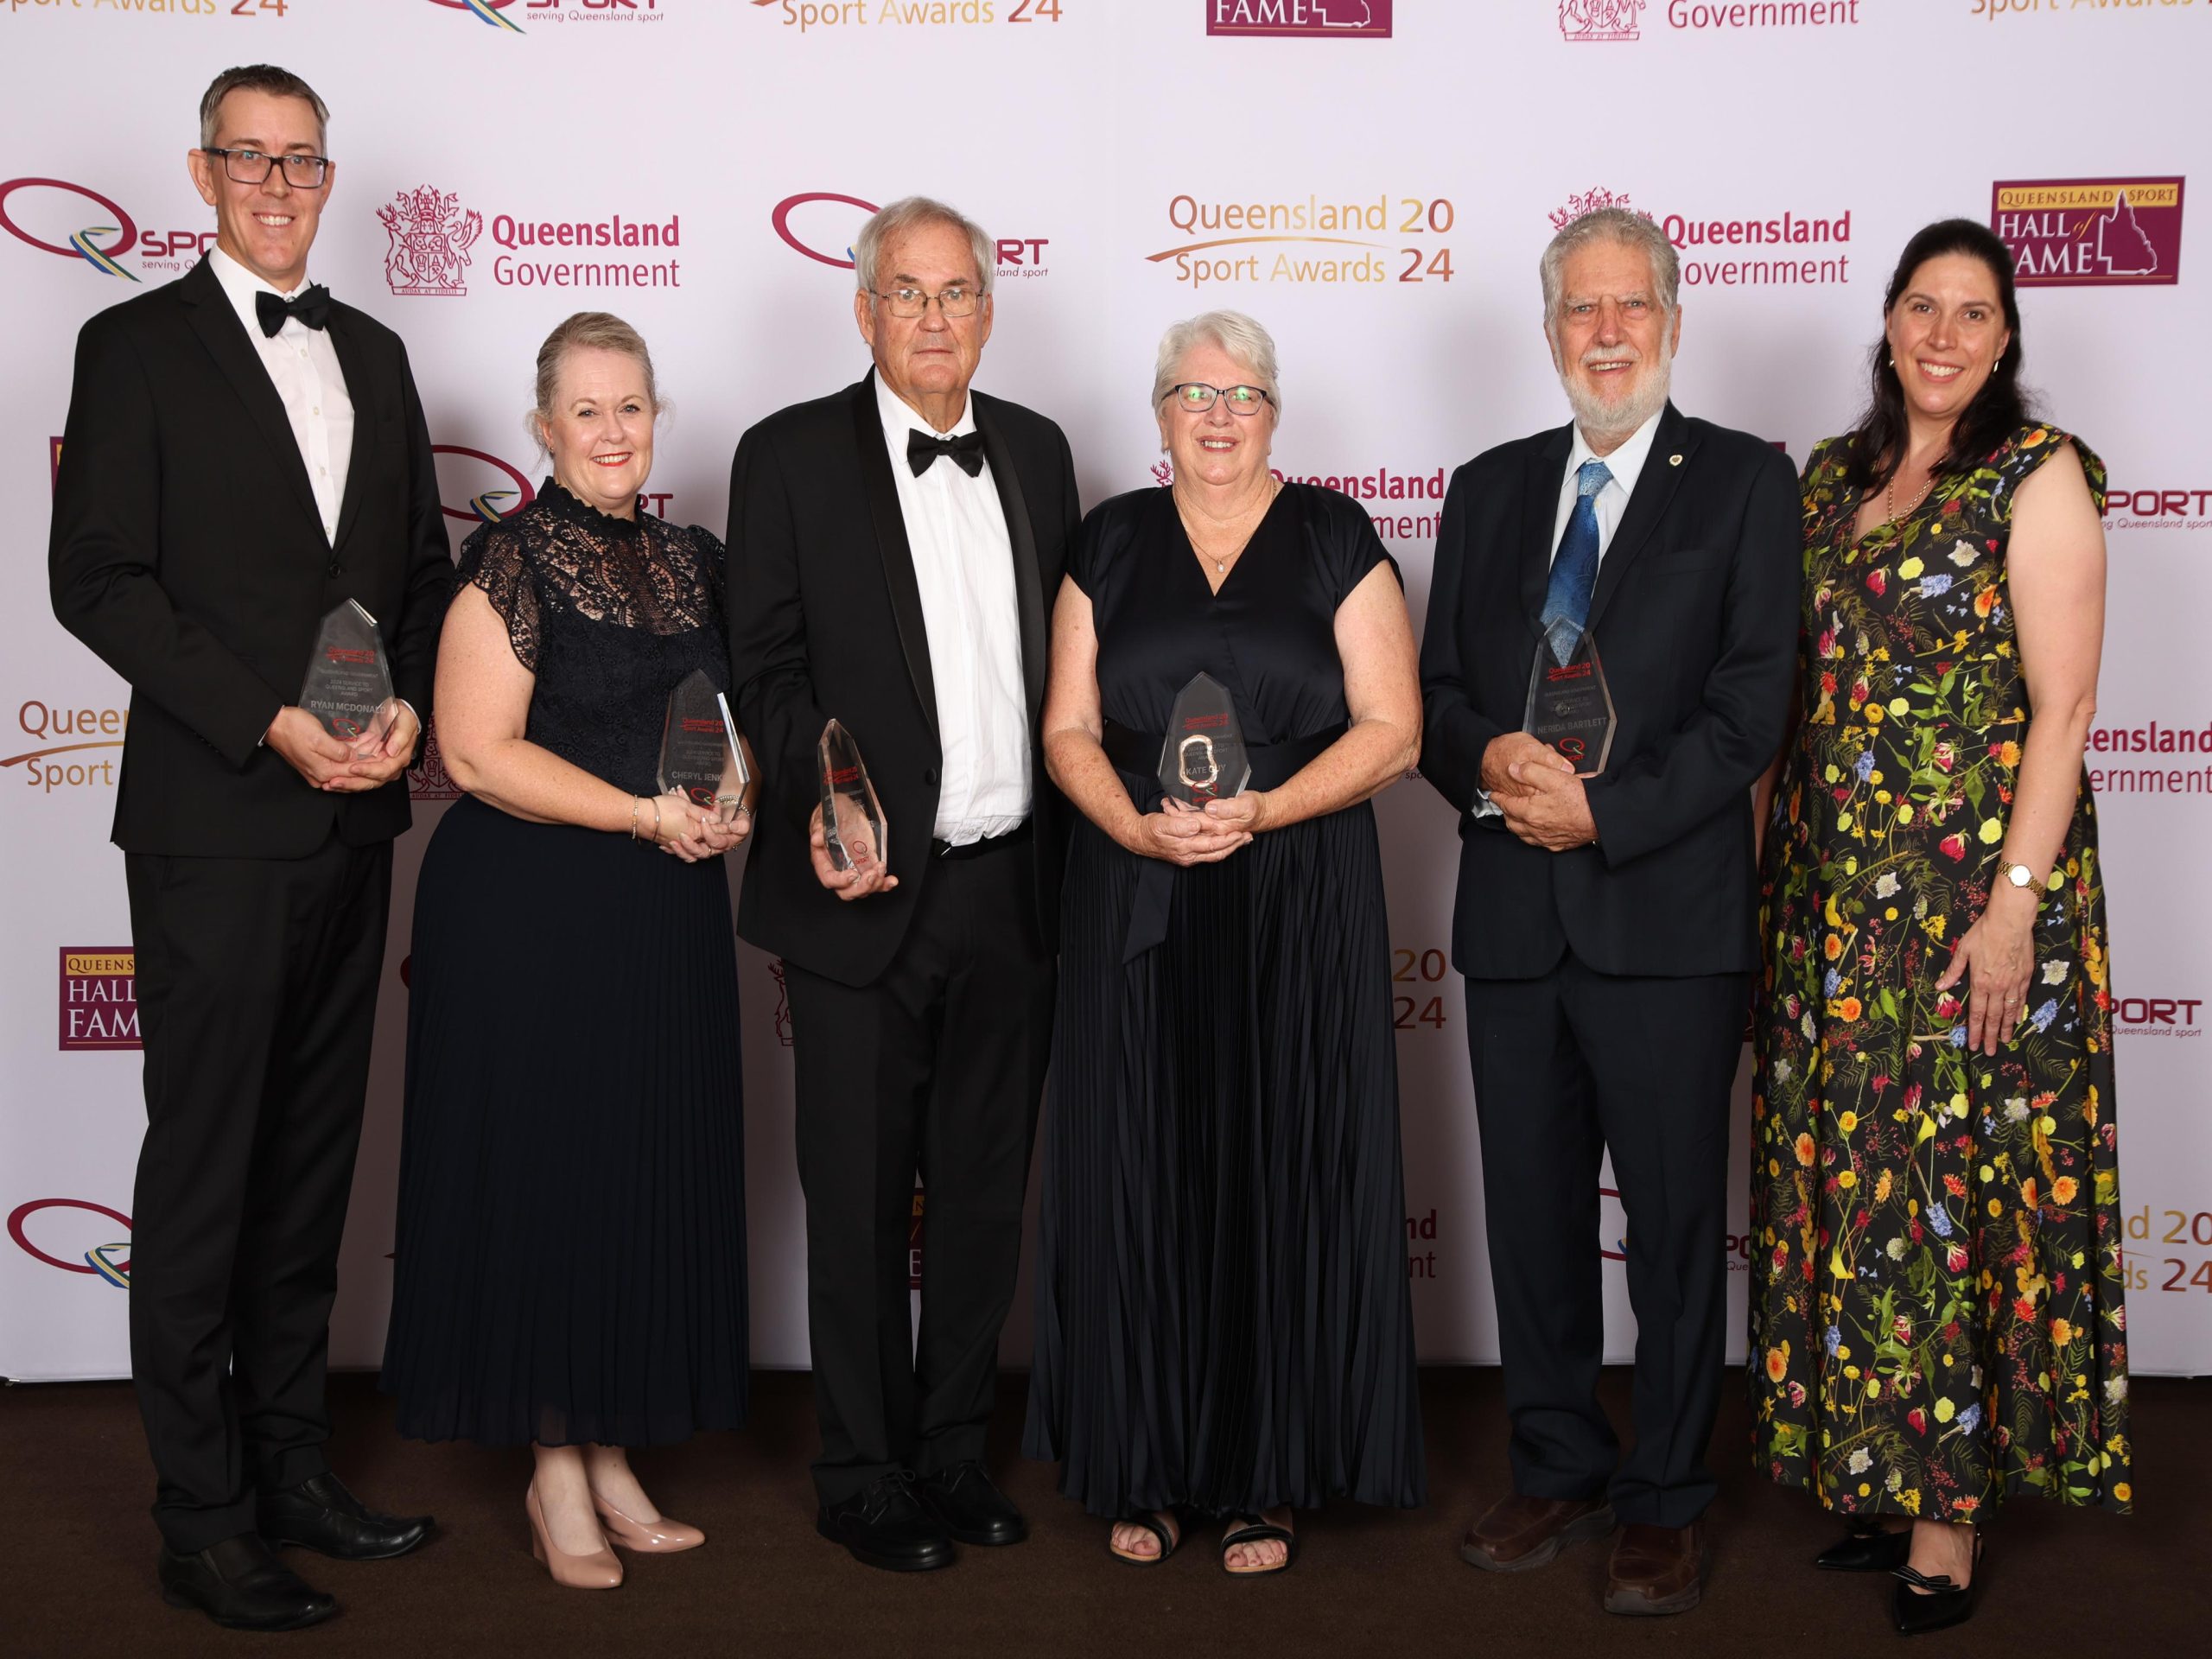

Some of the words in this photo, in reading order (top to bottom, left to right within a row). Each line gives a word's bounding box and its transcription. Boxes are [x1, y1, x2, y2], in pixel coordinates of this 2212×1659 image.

[526, 11, 564, 22] serving
[569, 10, 633, 22] Queensland
[638, 12, 664, 22] sport
[783, 0, 867, 33] Sport
[878, 0, 995, 25] Awards
[1007, 0, 1063, 22] 24
[1216, 0, 1307, 24] FAME
[1669, 0, 1859, 28] Government
[2000, 189, 2114, 207] QUEENSLAND
[2128, 188, 2177, 202] SPORT
[1169, 194, 1387, 235] Queensland
[1399, 199, 1454, 233] 20
[1999, 213, 2072, 238] HALL
[2073, 210, 2099, 243] of
[492, 214, 680, 250] Queensland
[1662, 210, 1851, 250] Queensland
[142, 259, 180, 271] serving
[493, 256, 680, 287] Government
[1175, 252, 1259, 289] Sport
[1269, 252, 1386, 283] Awards
[1398, 248, 1455, 283] 24
[1677, 255, 1850, 285] overnment
[2005, 242, 2094, 275] AME
[1022, 268, 1048, 279] sport
[2102, 491, 2212, 516] PORT
[2118, 518, 2183, 529] Queensland
[310, 700, 334, 710] RYAN
[335, 702, 386, 714] MCDONALD
[1537, 723, 1567, 735] NERIDA
[1567, 717, 1607, 730] BARTLETT
[2084, 721, 2212, 753] ensland
[27, 758, 113, 793] Sport
[671, 771, 702, 781] CHERYL
[704, 773, 722, 782] JENK
[1185, 766, 1207, 776] KATE
[1405, 772, 1423, 781] spo
[2089, 766, 2212, 793] ernment
[68, 957, 134, 974] QUEENS
[1392, 949, 1446, 982] 20
[67, 979, 137, 1002] HALL
[67, 1007, 141, 1038] FAM
[1393, 996, 1446, 1029] 24
[2176, 1027, 2202, 1039] sport
[2162, 1210, 2212, 1246] 20
[2161, 1258, 2212, 1294] 24
